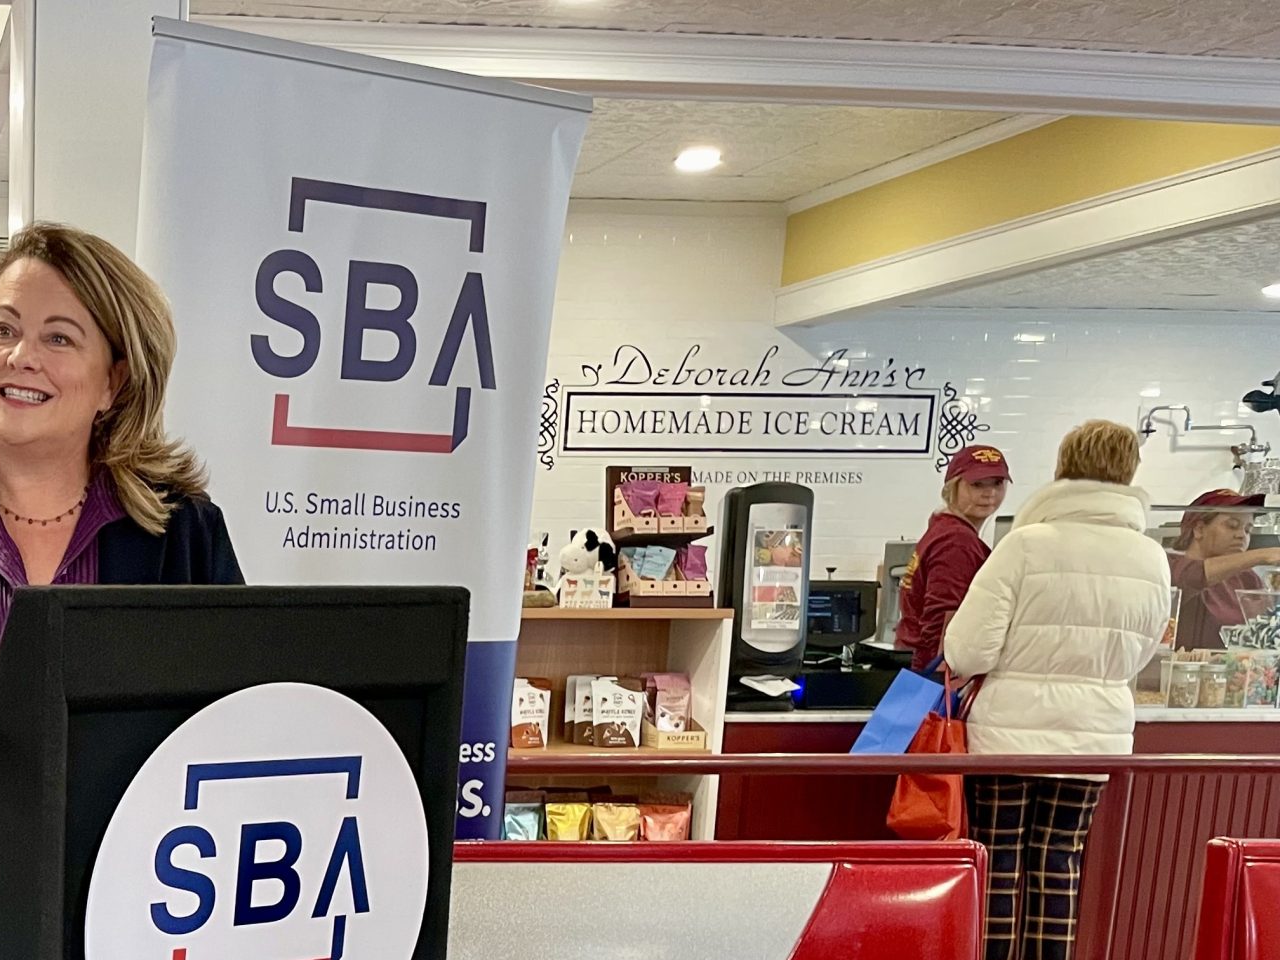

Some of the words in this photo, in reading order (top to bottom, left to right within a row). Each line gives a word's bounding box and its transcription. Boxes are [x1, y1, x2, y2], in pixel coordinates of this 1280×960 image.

[250, 249, 496, 390] SBA
[605, 344, 778, 387] Deborah
[781, 348, 898, 392] Ann's
[577, 409, 753, 435] HOMEMADE
[763, 411, 810, 435] ICE
[820, 411, 922, 436] CREAM
[620, 471, 681, 483] KOPPER'S
[692, 471, 733, 484] MADE
[737, 471, 758, 484] ON
[763, 471, 791, 483] THE
[796, 471, 863, 484] PREMISES
[265, 490, 298, 514] U.S.
[305, 492, 365, 516] Small
[373, 495, 461, 519] Business
[282, 526, 437, 551] Administration
[459, 742, 496, 763] ess
[457, 779, 491, 818] S.
[150, 816, 370, 935] SBA
